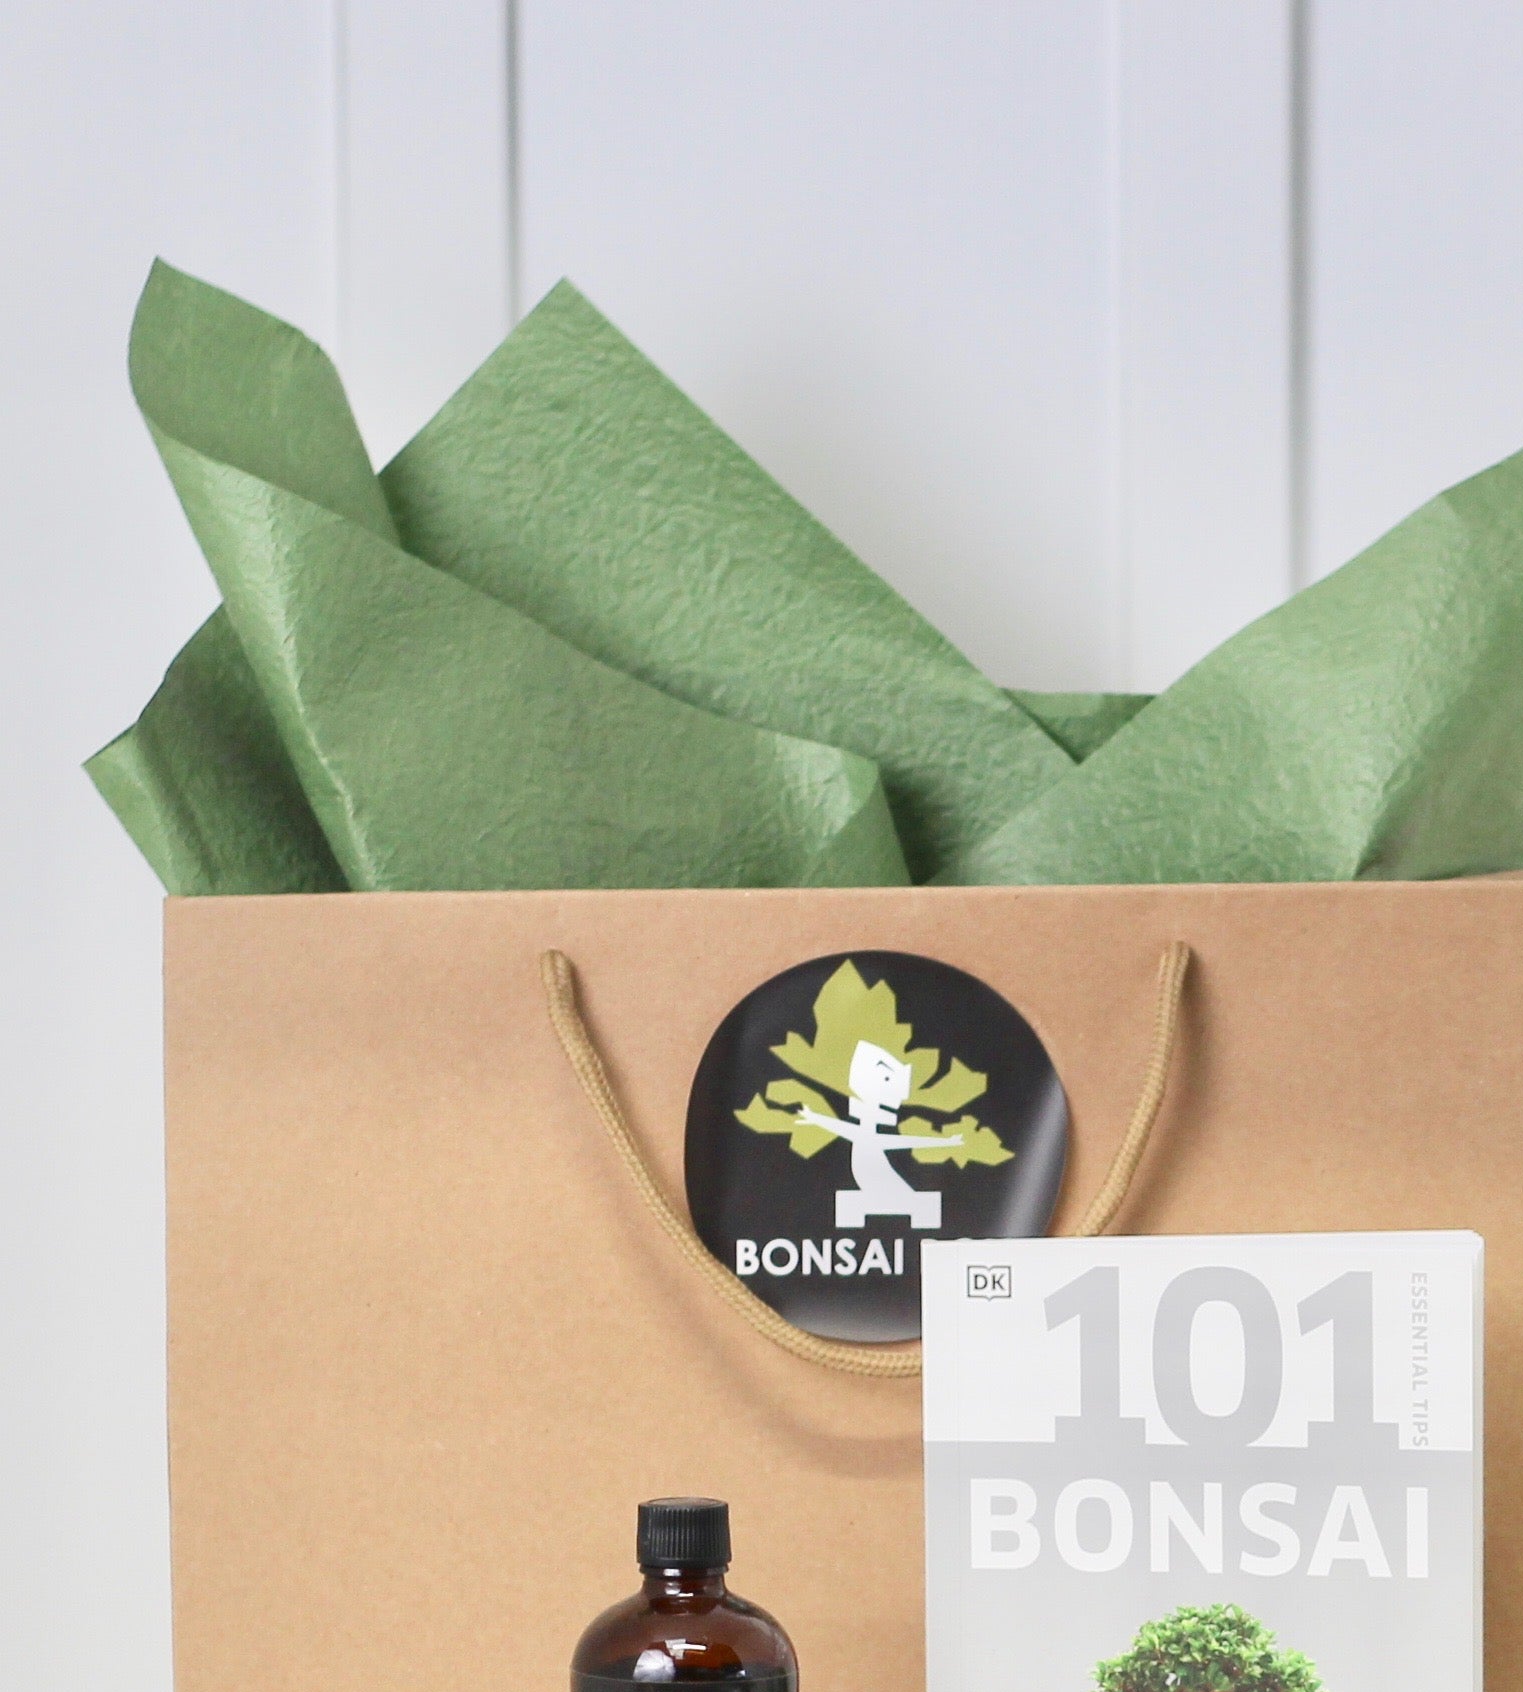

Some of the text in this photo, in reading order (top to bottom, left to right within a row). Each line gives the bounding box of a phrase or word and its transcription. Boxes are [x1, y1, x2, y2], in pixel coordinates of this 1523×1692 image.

[735, 1238, 905, 1277] BONSAI
[972, 1274, 1004, 1290] DK
[1043, 1265, 1400, 1449] 101
[1410, 1272, 1429, 1447] ESSENTIAL TIPS
[969, 1477, 1429, 1579] BONSAI
